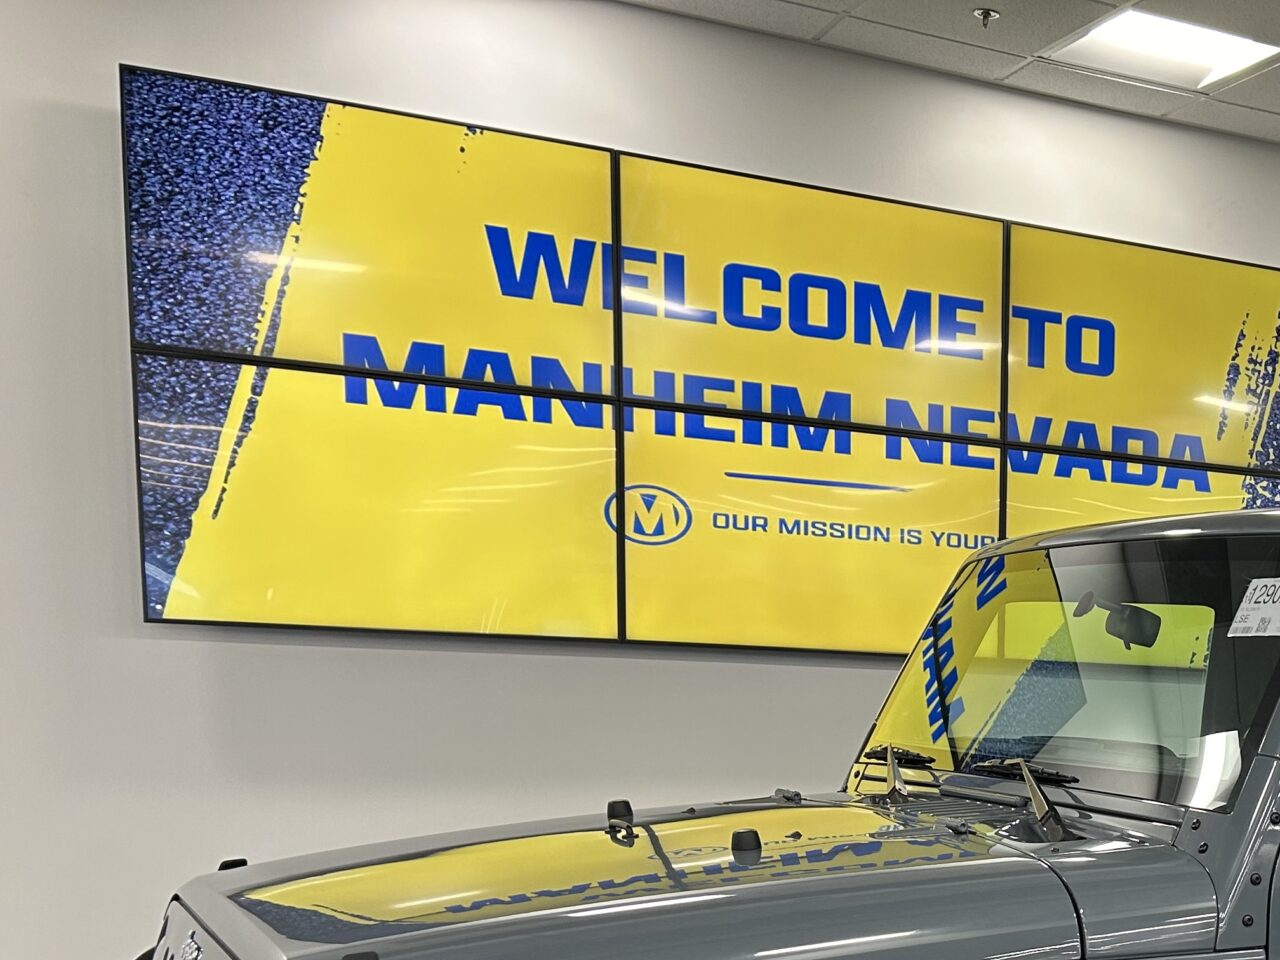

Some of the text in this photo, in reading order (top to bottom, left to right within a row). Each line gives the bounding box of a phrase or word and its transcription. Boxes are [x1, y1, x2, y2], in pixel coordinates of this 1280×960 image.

[486, 226, 1115, 377] WELCOME TO
[342, 333, 1211, 493] MANHEIM NEVADA
[713, 512, 769, 534] OUR
[779, 517, 890, 543] MISSION
[900, 528, 923, 545] IS
